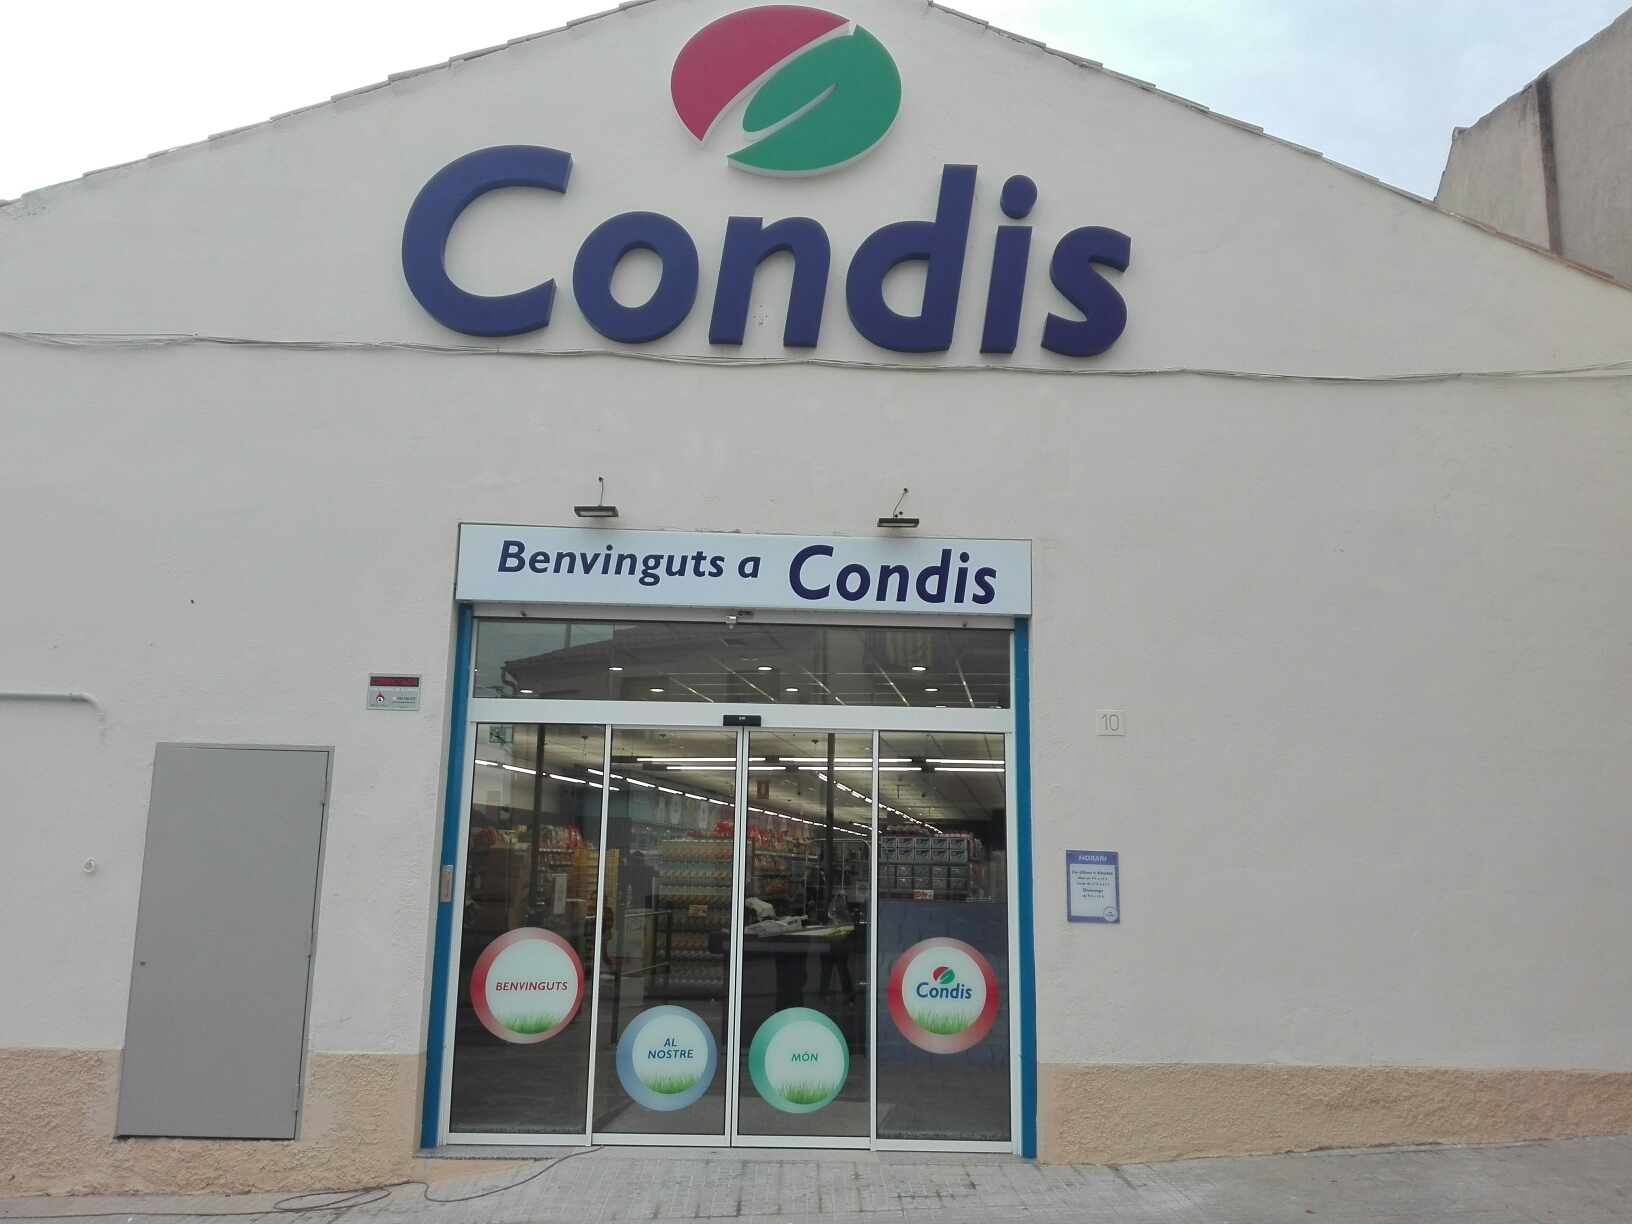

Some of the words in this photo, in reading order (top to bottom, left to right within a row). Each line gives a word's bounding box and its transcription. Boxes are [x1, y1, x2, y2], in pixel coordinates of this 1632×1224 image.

[401, 144, 1131, 358] Condis
[498, 540, 725, 586] Benvinguts
[737, 555, 761, 579] a
[789, 544, 997, 604] Condis
[1101, 713, 1120, 731] 10
[495, 981, 568, 991] BENVINGUTS
[916, 982, 972, 1000] Condis
[663, 1038, 677, 1047] AL
[648, 1049, 694, 1059] NOSTRE
[791, 1051, 819, 1062] MÓN
